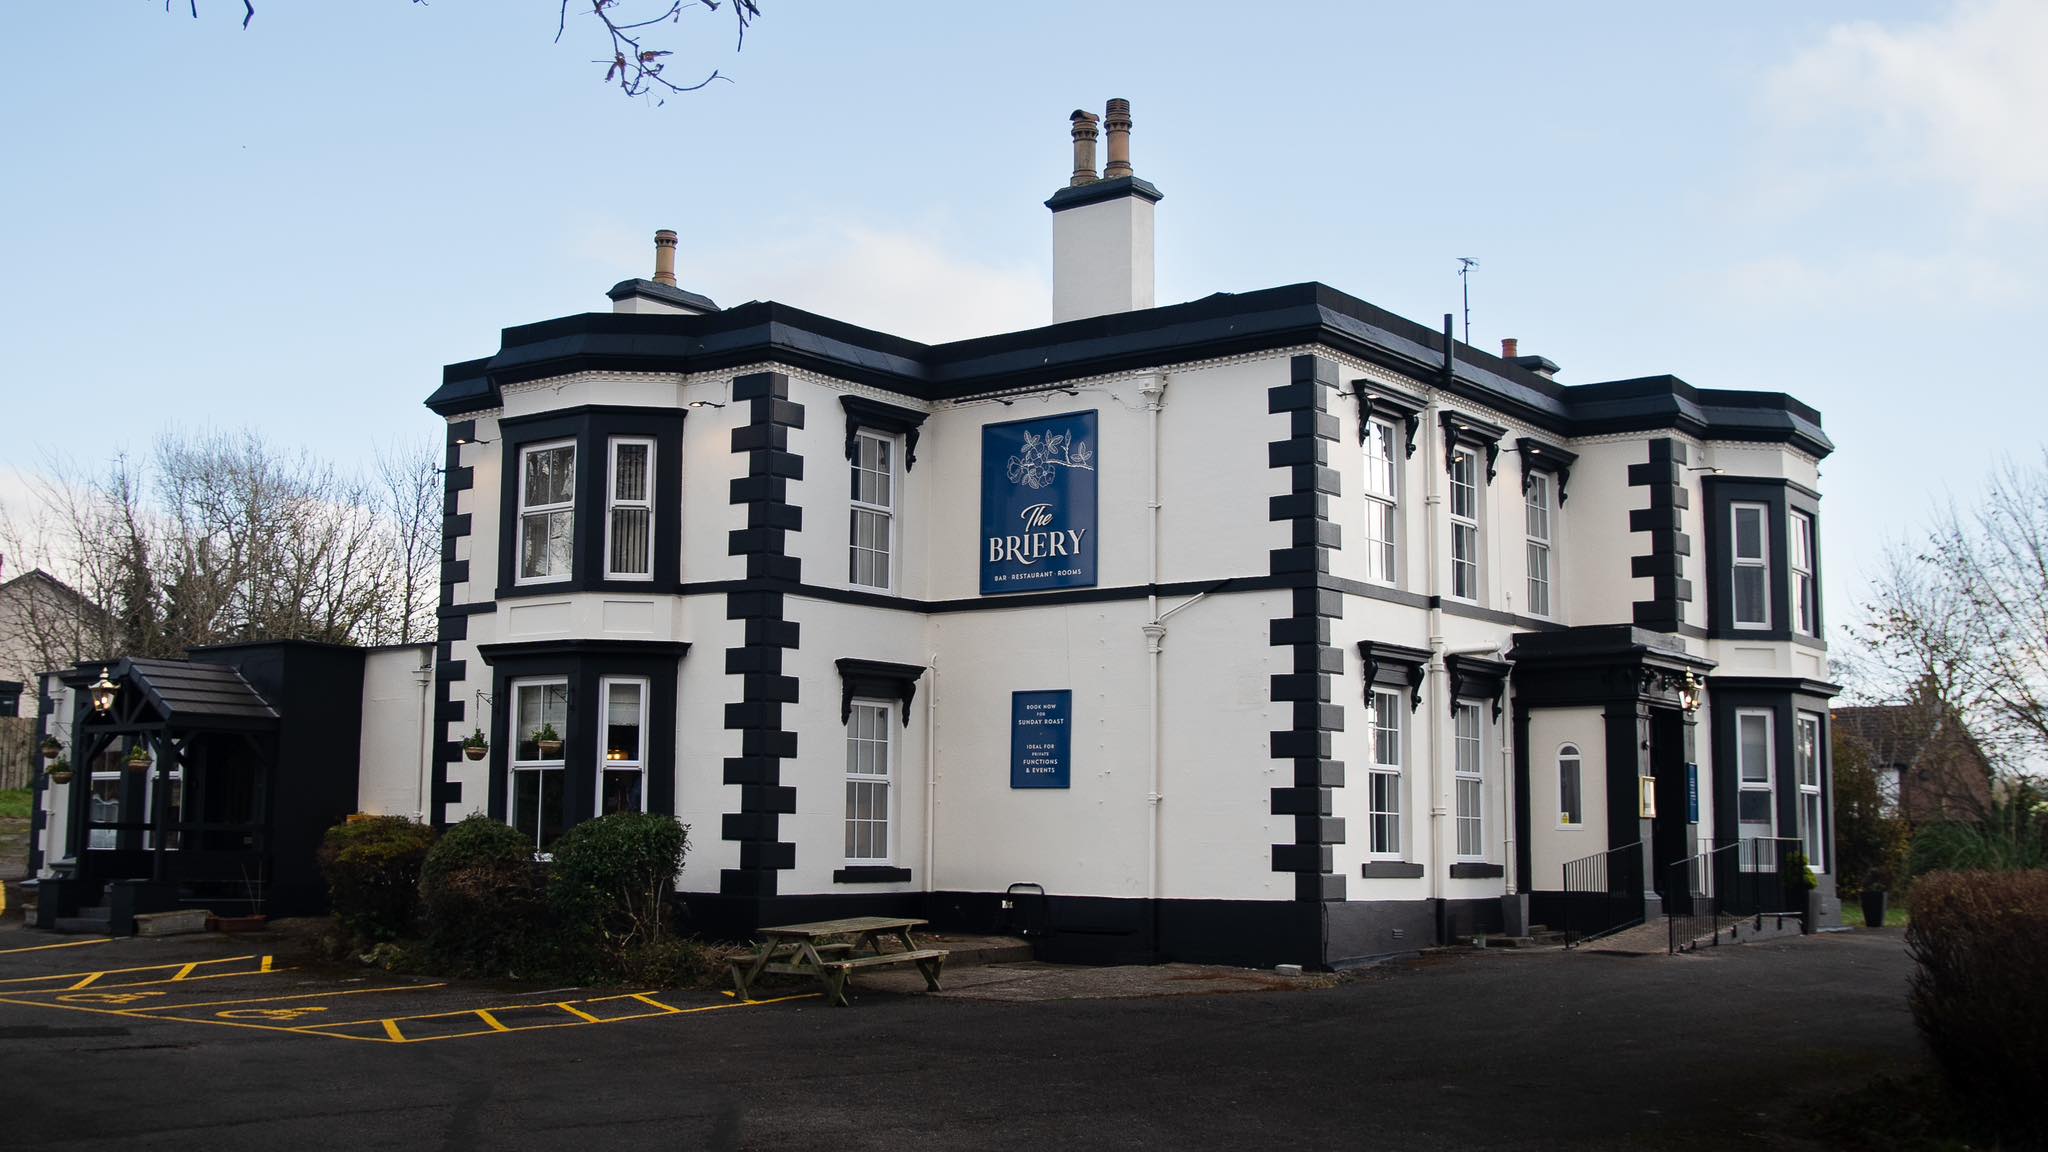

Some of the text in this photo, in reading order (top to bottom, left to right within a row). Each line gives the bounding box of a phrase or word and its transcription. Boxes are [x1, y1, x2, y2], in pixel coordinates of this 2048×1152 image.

[1020, 503, 1053, 532] The
[989, 528, 1086, 565] BRIERY
[1011, 571, 1053, 580] RESTAURANT
[1058, 568, 1082, 576] ROOMS
